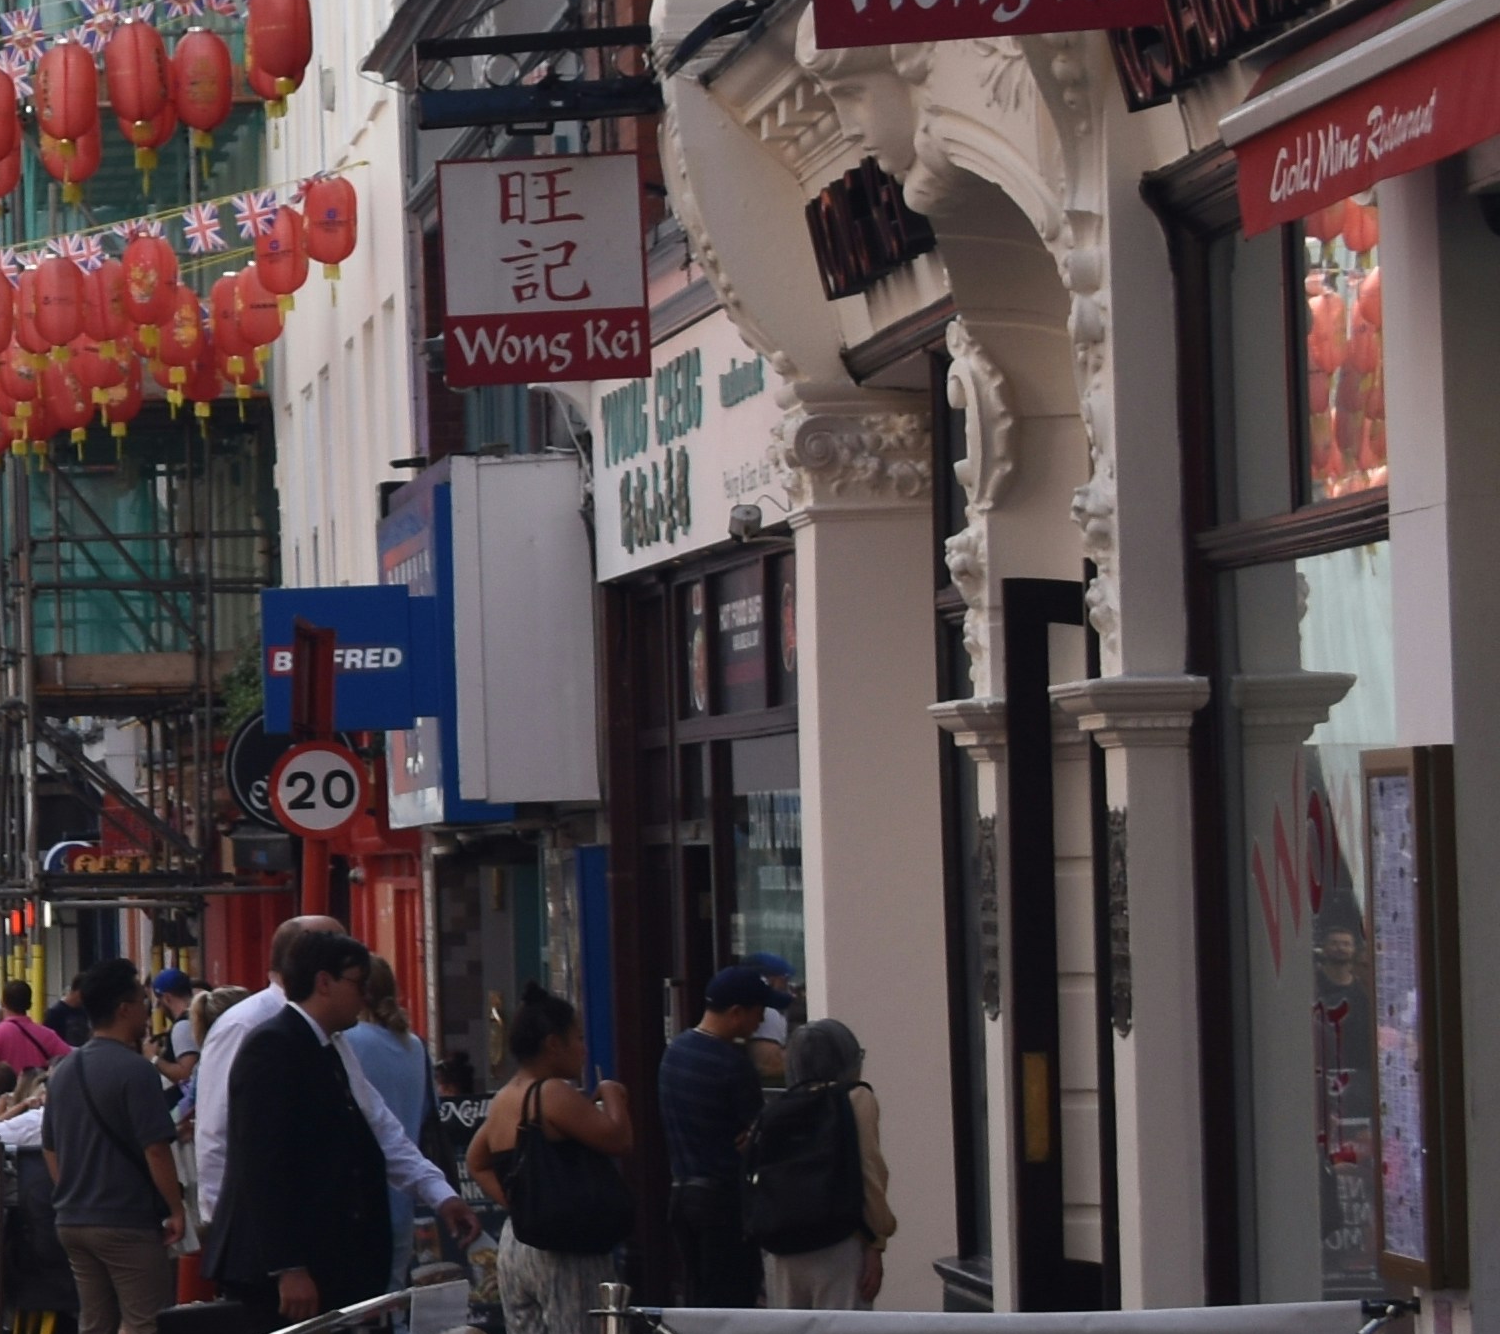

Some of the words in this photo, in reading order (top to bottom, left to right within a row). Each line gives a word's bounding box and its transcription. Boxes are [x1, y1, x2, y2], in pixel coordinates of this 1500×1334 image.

[1269, 137, 1316, 203] Gold
[1314, 123, 1360, 193] Mine
[499, 166, 594, 304] 旺記
[453, 323, 573, 374] Wong
[584, 316, 643, 361] Kei
[274, 647, 403, 672] BFRED
[286, 770, 356, 810] 20
